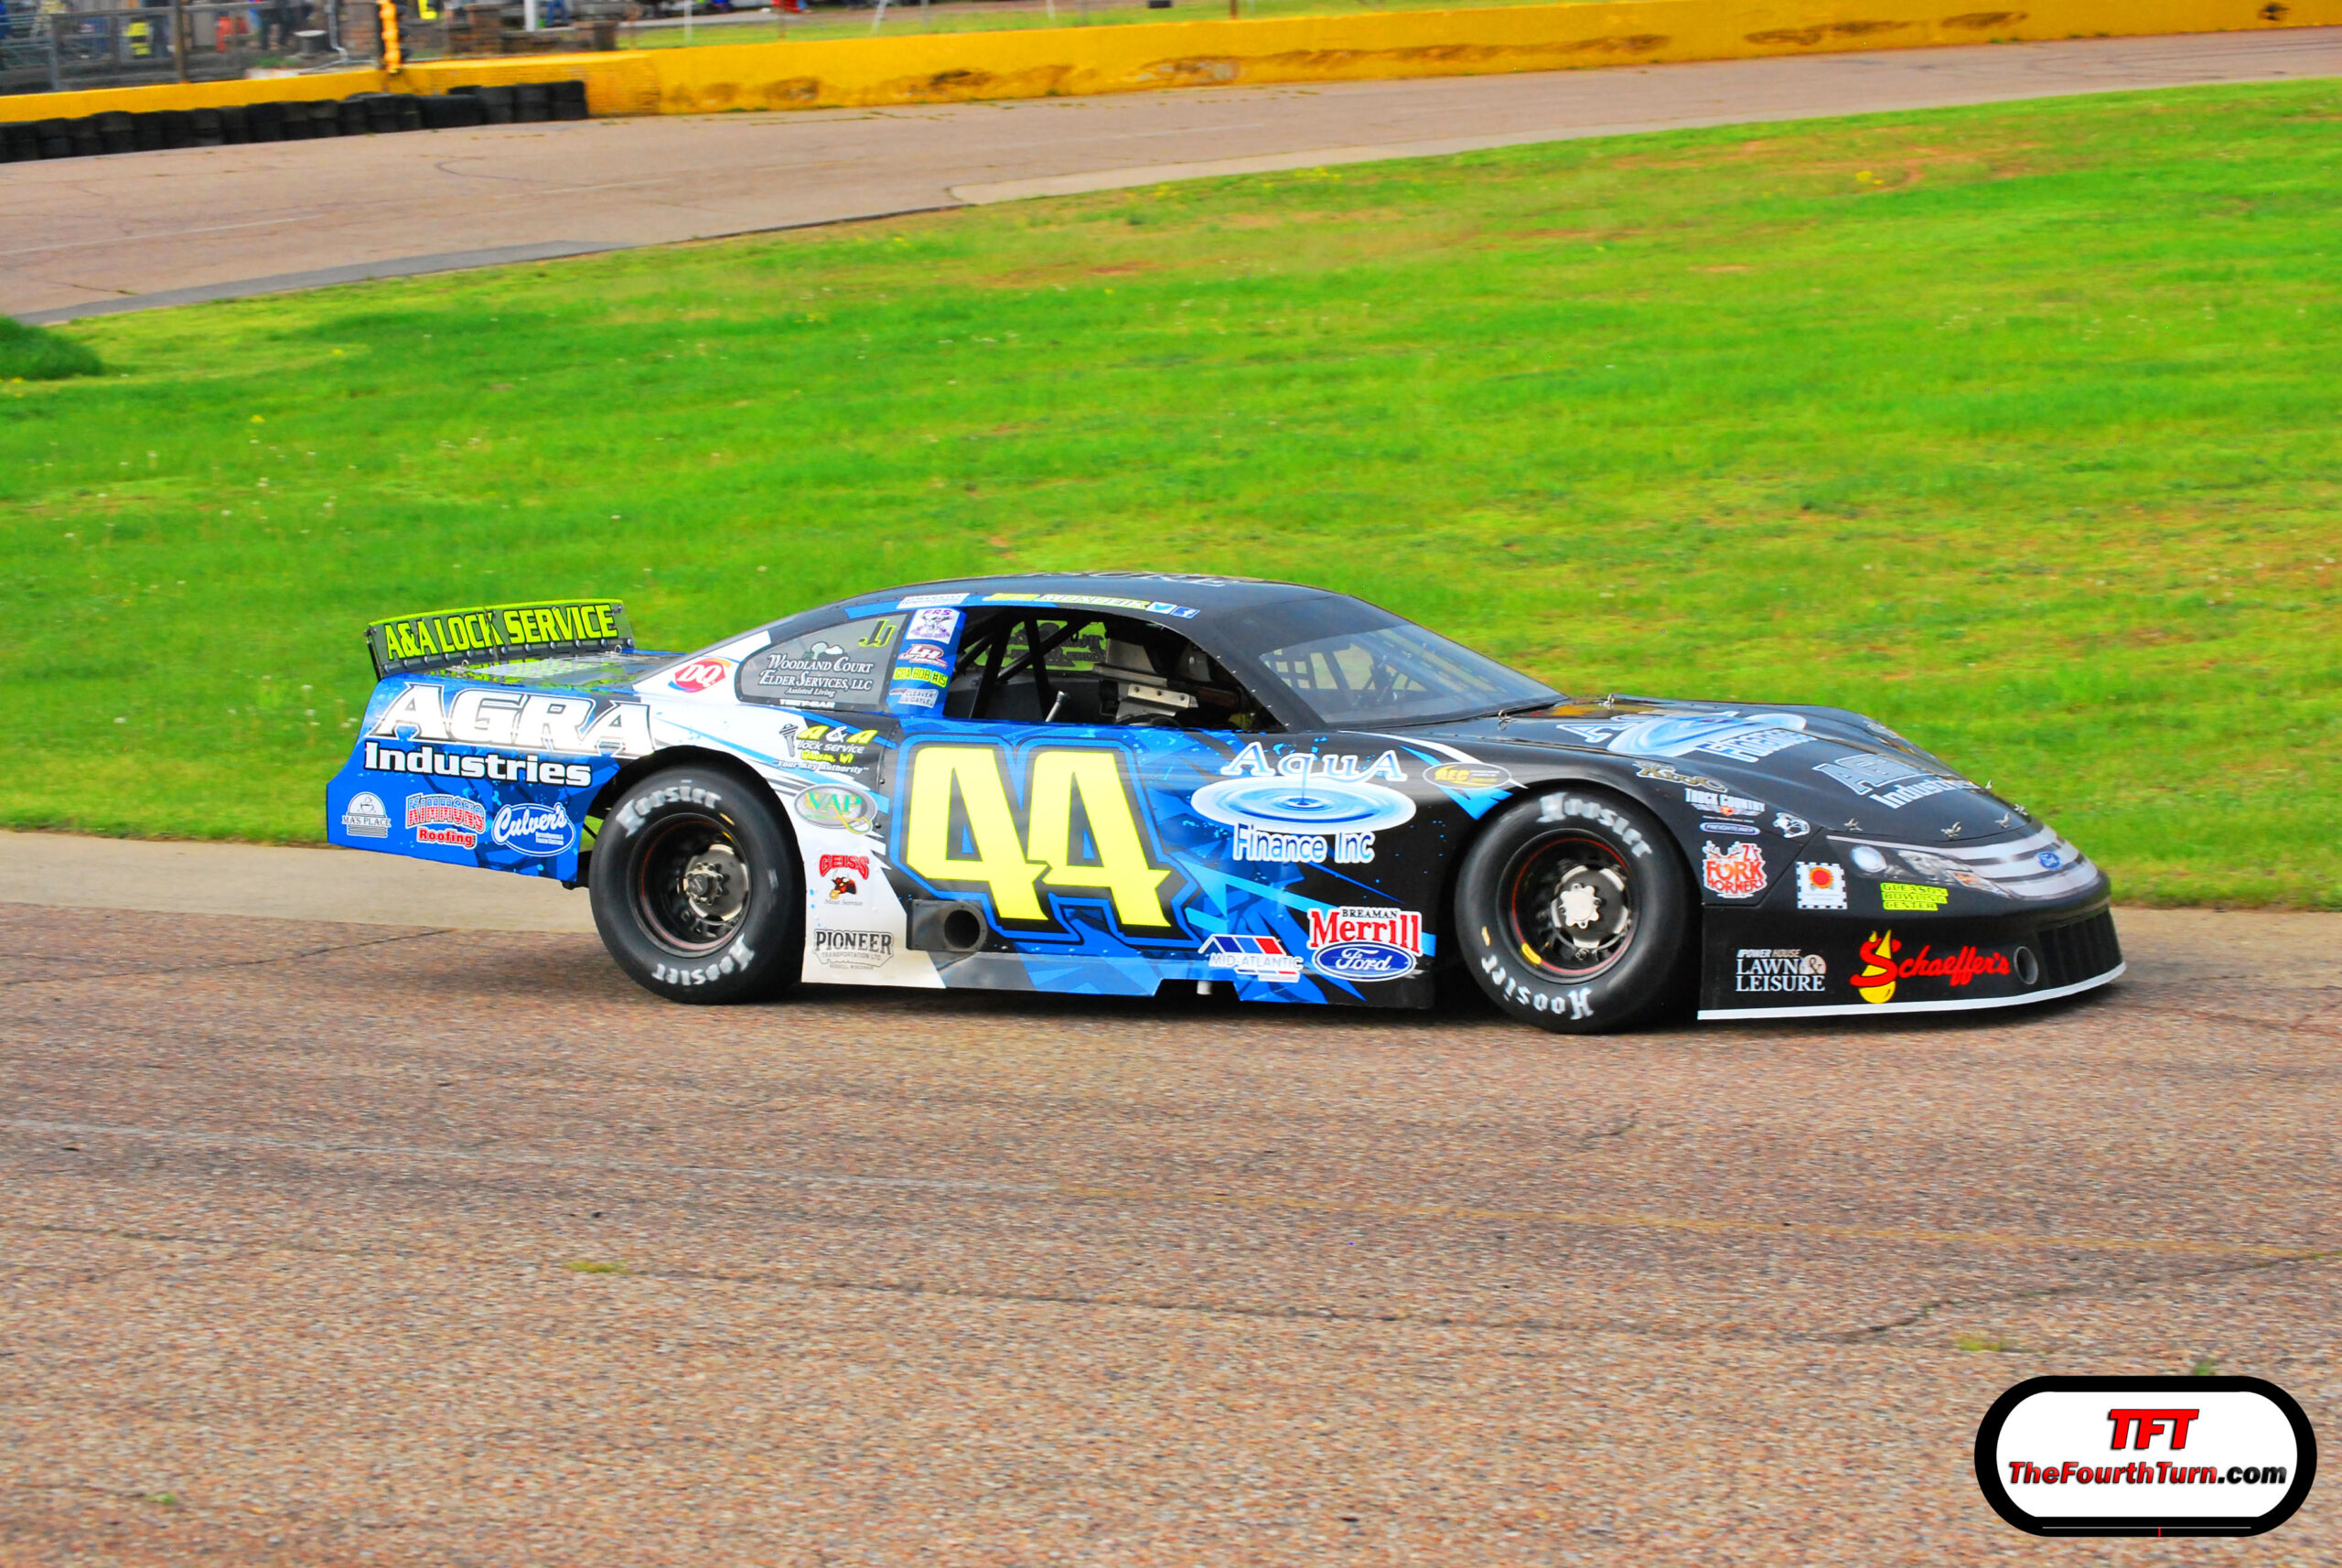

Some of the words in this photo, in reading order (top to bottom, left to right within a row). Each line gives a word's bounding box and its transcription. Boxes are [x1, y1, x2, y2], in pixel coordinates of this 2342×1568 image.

[384, 619, 438, 660] A&A
[434, 611, 504, 653] LOCK
[504, 604, 618, 645] SERVICE
[768, 653, 833, 671] WOODLAND
[833, 656, 874, 673] COURT
[677, 664, 723, 688] DQ
[758, 670, 799, 686] ELDER
[851, 680, 873, 690] LLC
[786, 687, 813, 695] Assisted
[813, 688, 836, 697] Living
[365, 682, 655, 758] AGRA
[797, 725, 829, 739] A
[825, 726, 847, 742] &
[846, 729, 878, 744] A
[365, 742, 593, 787] Industries
[363, 816, 391, 827] PLACE
[495, 804, 568, 843] Culver's
[419, 828, 473, 847] Roofing
[907, 746, 1171, 927] 44
[1232, 822, 1327, 863] Finance
[1334, 831, 1375, 863] Inc
[820, 854, 869, 880] GEISS
[1706, 861, 1763, 881] FORK
[1341, 908, 1398, 919] BREAMAN
[815, 931, 892, 955] PIONEER
[1311, 911, 1419, 953] Merrill
[1210, 953, 1303, 969] MID-ATLANTIC
[1336, 948, 1391, 972] Ford
[1735, 959, 1799, 974] LAWN
[1850, 939, 2011, 988] Schaeffer's
[1481, 954, 1594, 1019] Hoosier
[1735, 975, 1825, 992] LEISURE
